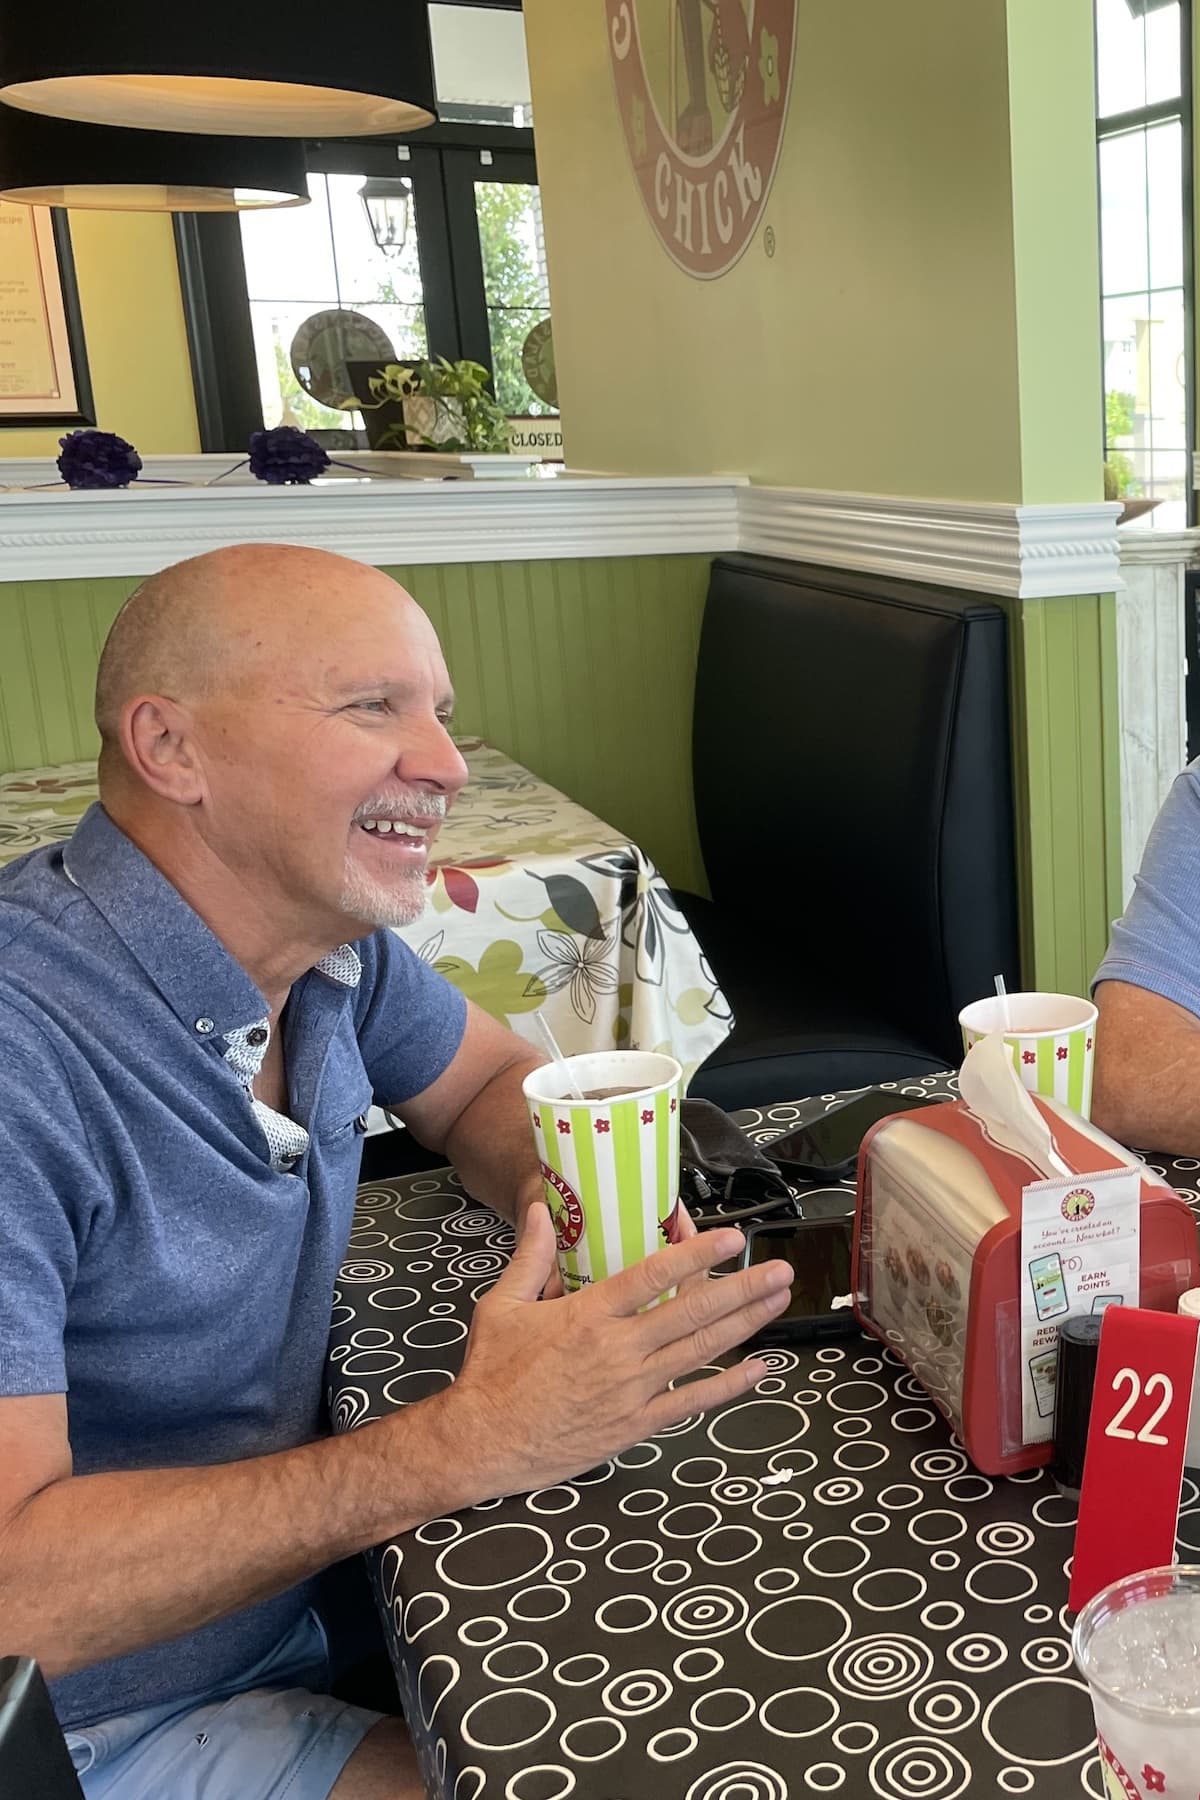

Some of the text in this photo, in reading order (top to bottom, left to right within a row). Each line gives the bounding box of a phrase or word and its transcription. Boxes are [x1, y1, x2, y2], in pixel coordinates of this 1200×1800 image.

[655, 119, 762, 255] CHICK
[511, 432, 563, 446] CLOSED
[550, 1173, 581, 1224] SALAD
[1076, 1233, 1095, 1244] Now
[1081, 1271, 1107, 1282] EARN
[1077, 1279, 1111, 1293] POINTS
[1105, 1367, 1174, 1446] 22
